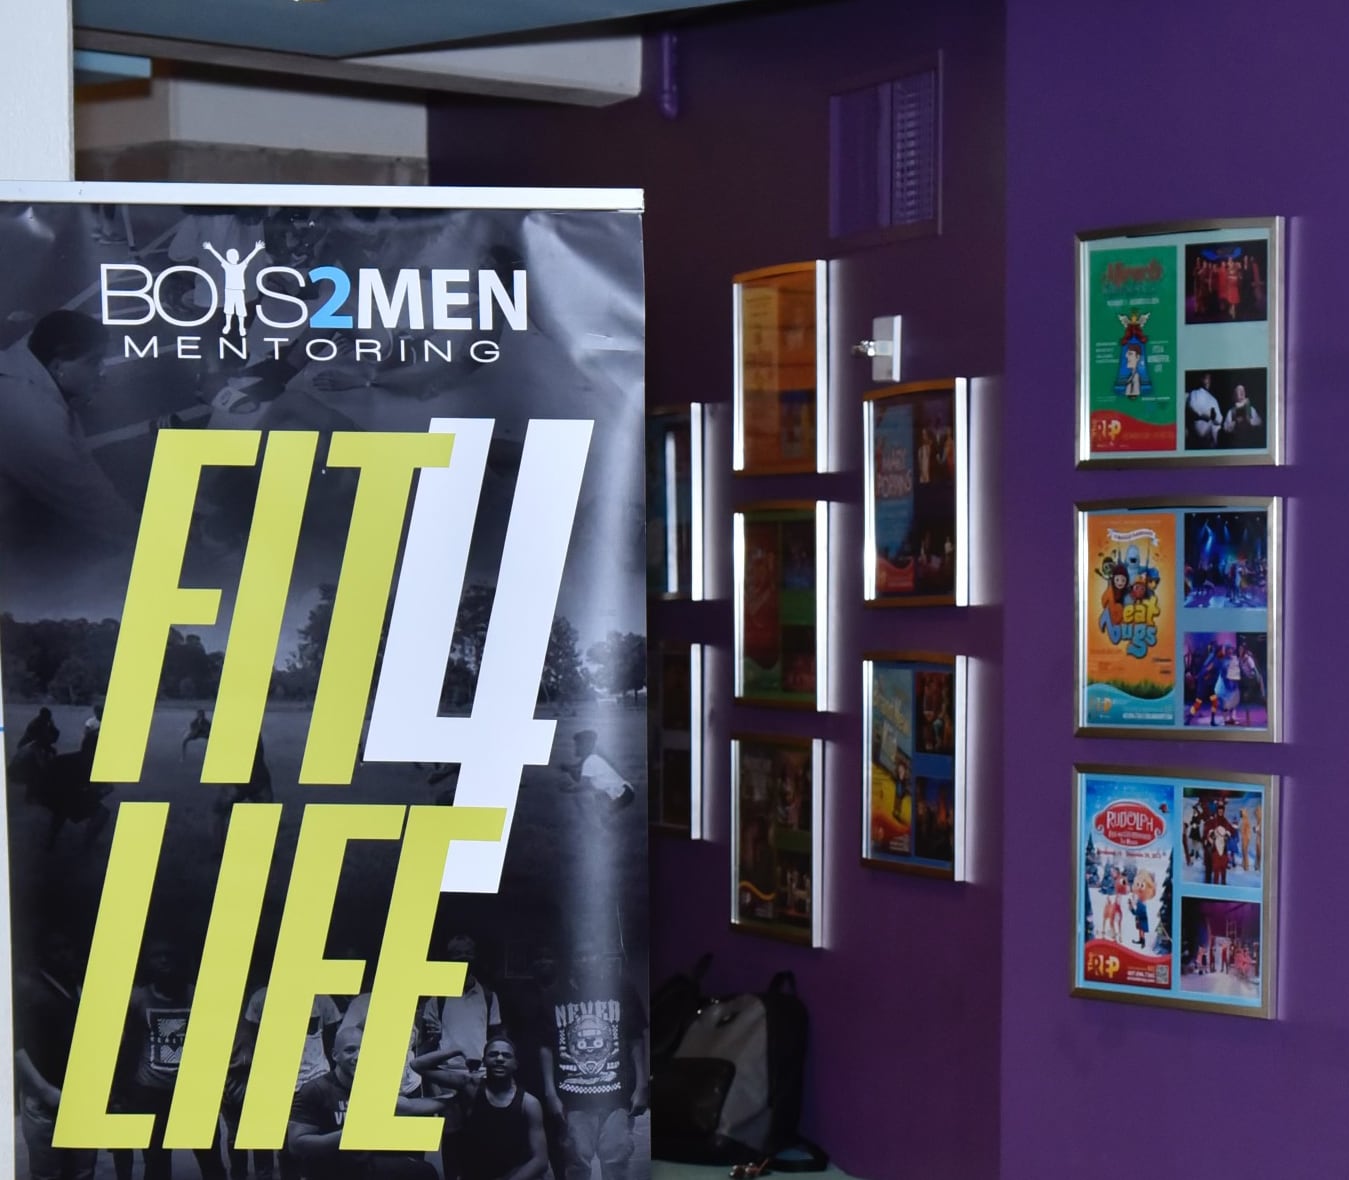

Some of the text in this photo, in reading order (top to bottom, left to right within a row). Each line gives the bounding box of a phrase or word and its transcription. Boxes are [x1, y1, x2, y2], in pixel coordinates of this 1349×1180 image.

[123, 335, 502, 364] MENTORING
[89, 428, 456, 785] FIT
[1102, 586, 1161, 626] beat
[1098, 604, 1159, 659] bugs
[1106, 810, 1154, 833] RUDOLPH
[51, 801, 508, 1152] LIFE
